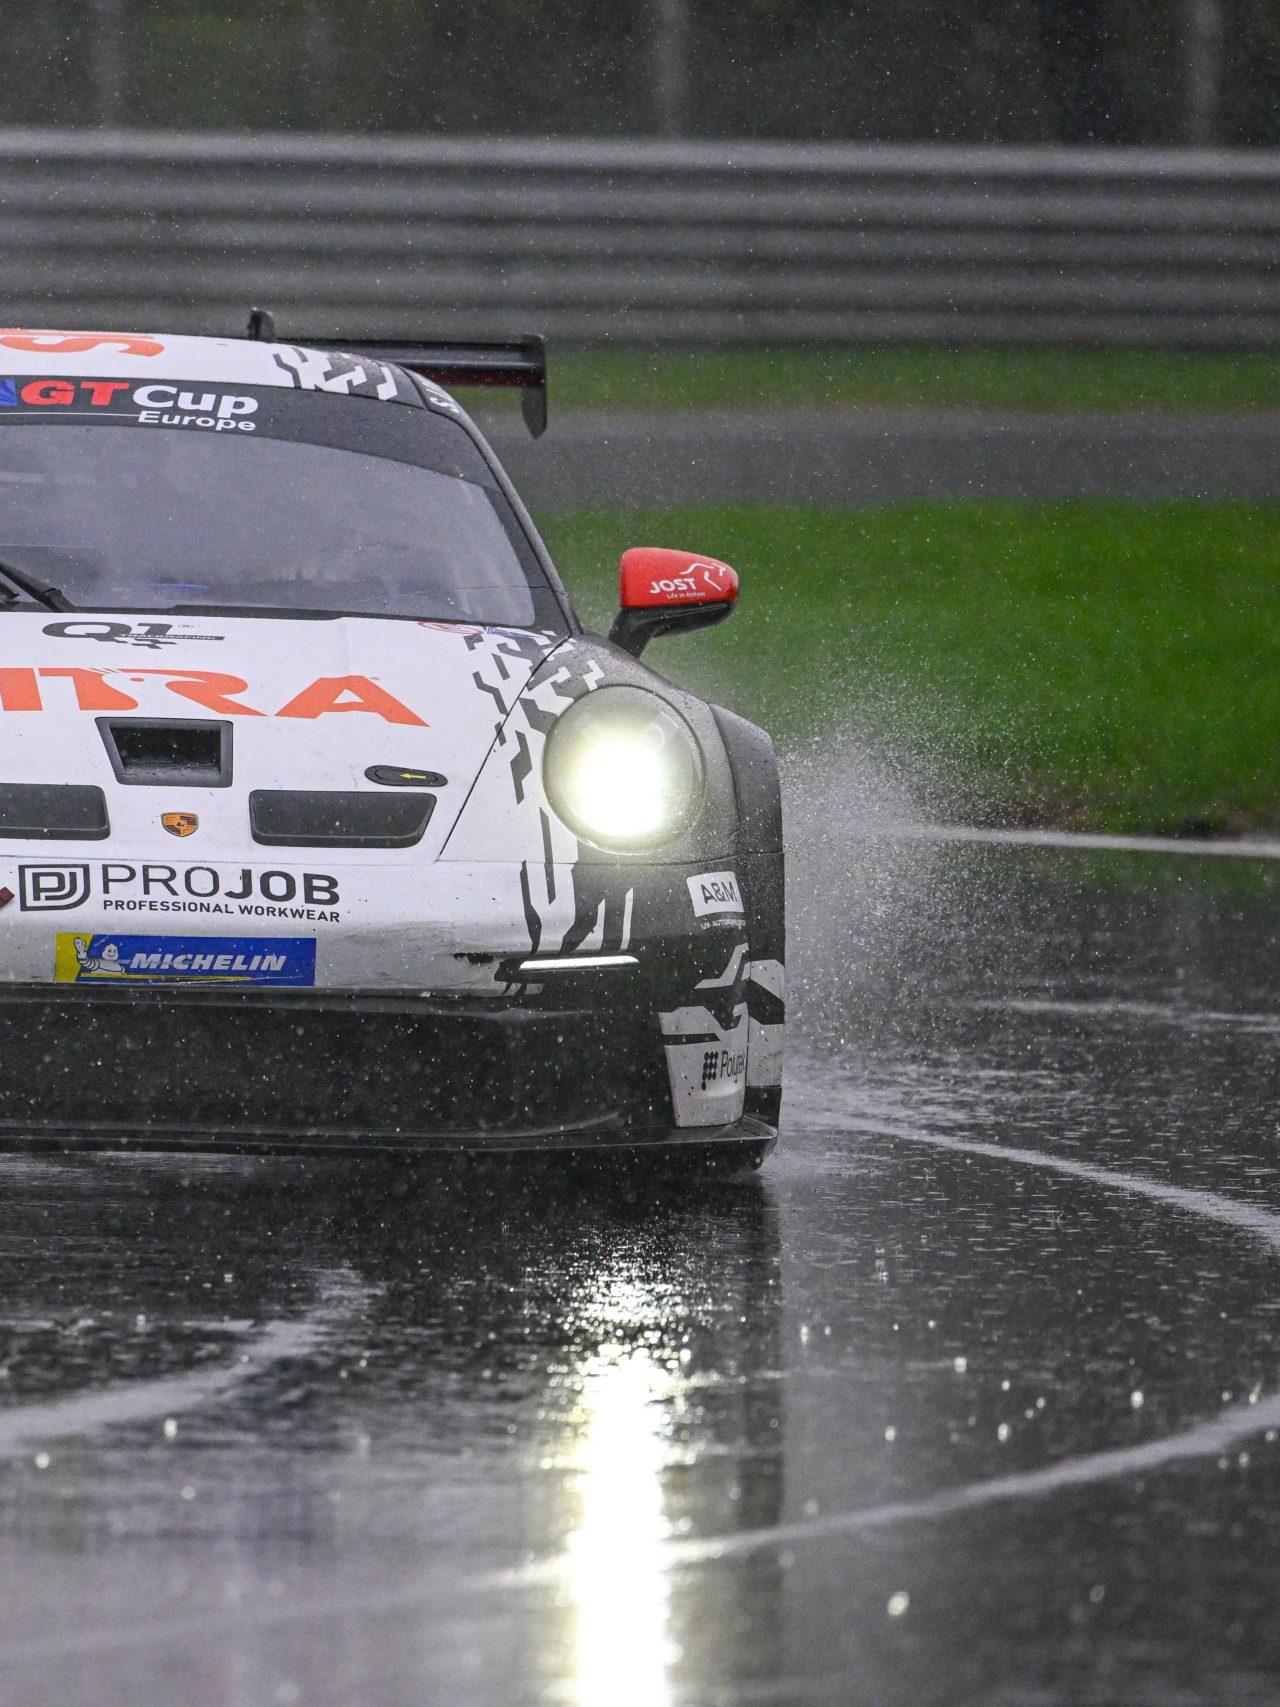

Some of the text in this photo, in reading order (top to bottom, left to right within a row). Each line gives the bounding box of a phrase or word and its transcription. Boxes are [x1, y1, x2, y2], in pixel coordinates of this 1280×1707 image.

[21, 379, 259, 418] GT Cup
[138, 410, 257, 432] Europe
[650, 577, 696, 594] JOST
[102, 863, 340, 906] PROJOB
[700, 881, 738, 904] A&M
[103, 900, 340, 923] PROFESSIONAL WORKWEAR
[130, 953, 286, 971] MICHELIN
